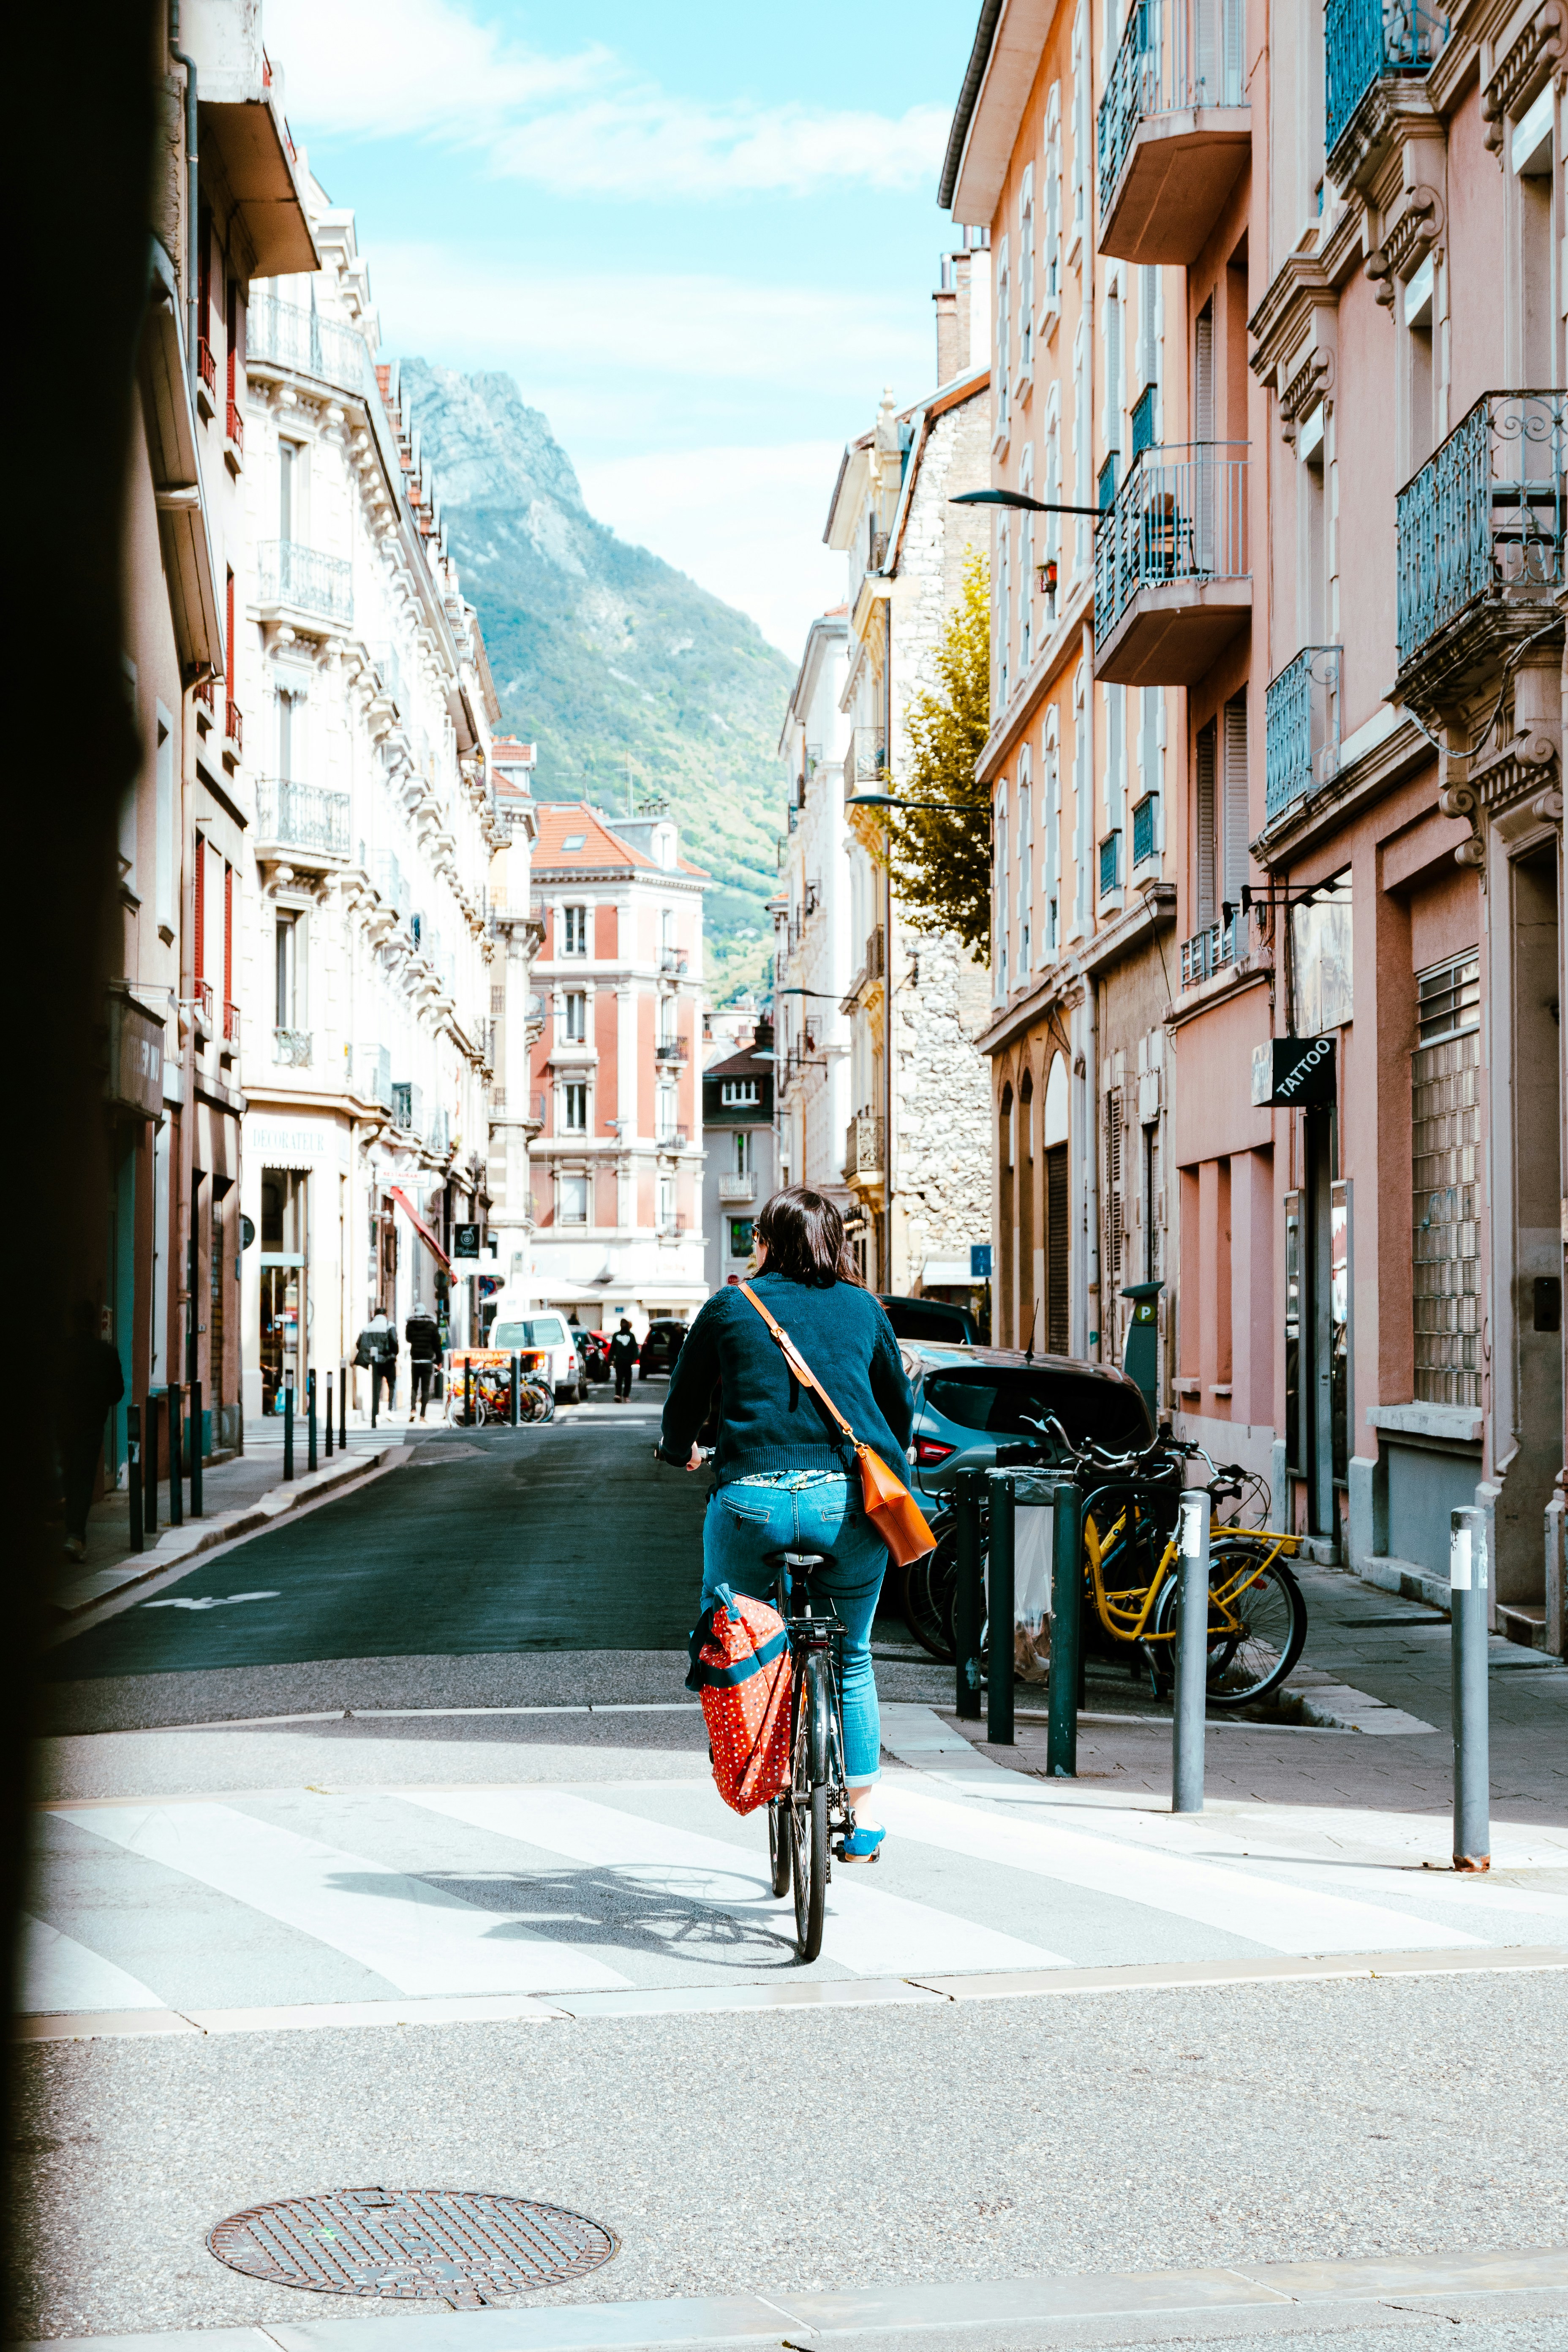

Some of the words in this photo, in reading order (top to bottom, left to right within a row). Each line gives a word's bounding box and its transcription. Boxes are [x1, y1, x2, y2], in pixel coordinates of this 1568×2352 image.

[1276, 1040, 1330, 1097] TATTOO
[253, 1128, 324, 1151] DECORATEUR
[1142, 1306, 1151, 1320] P
